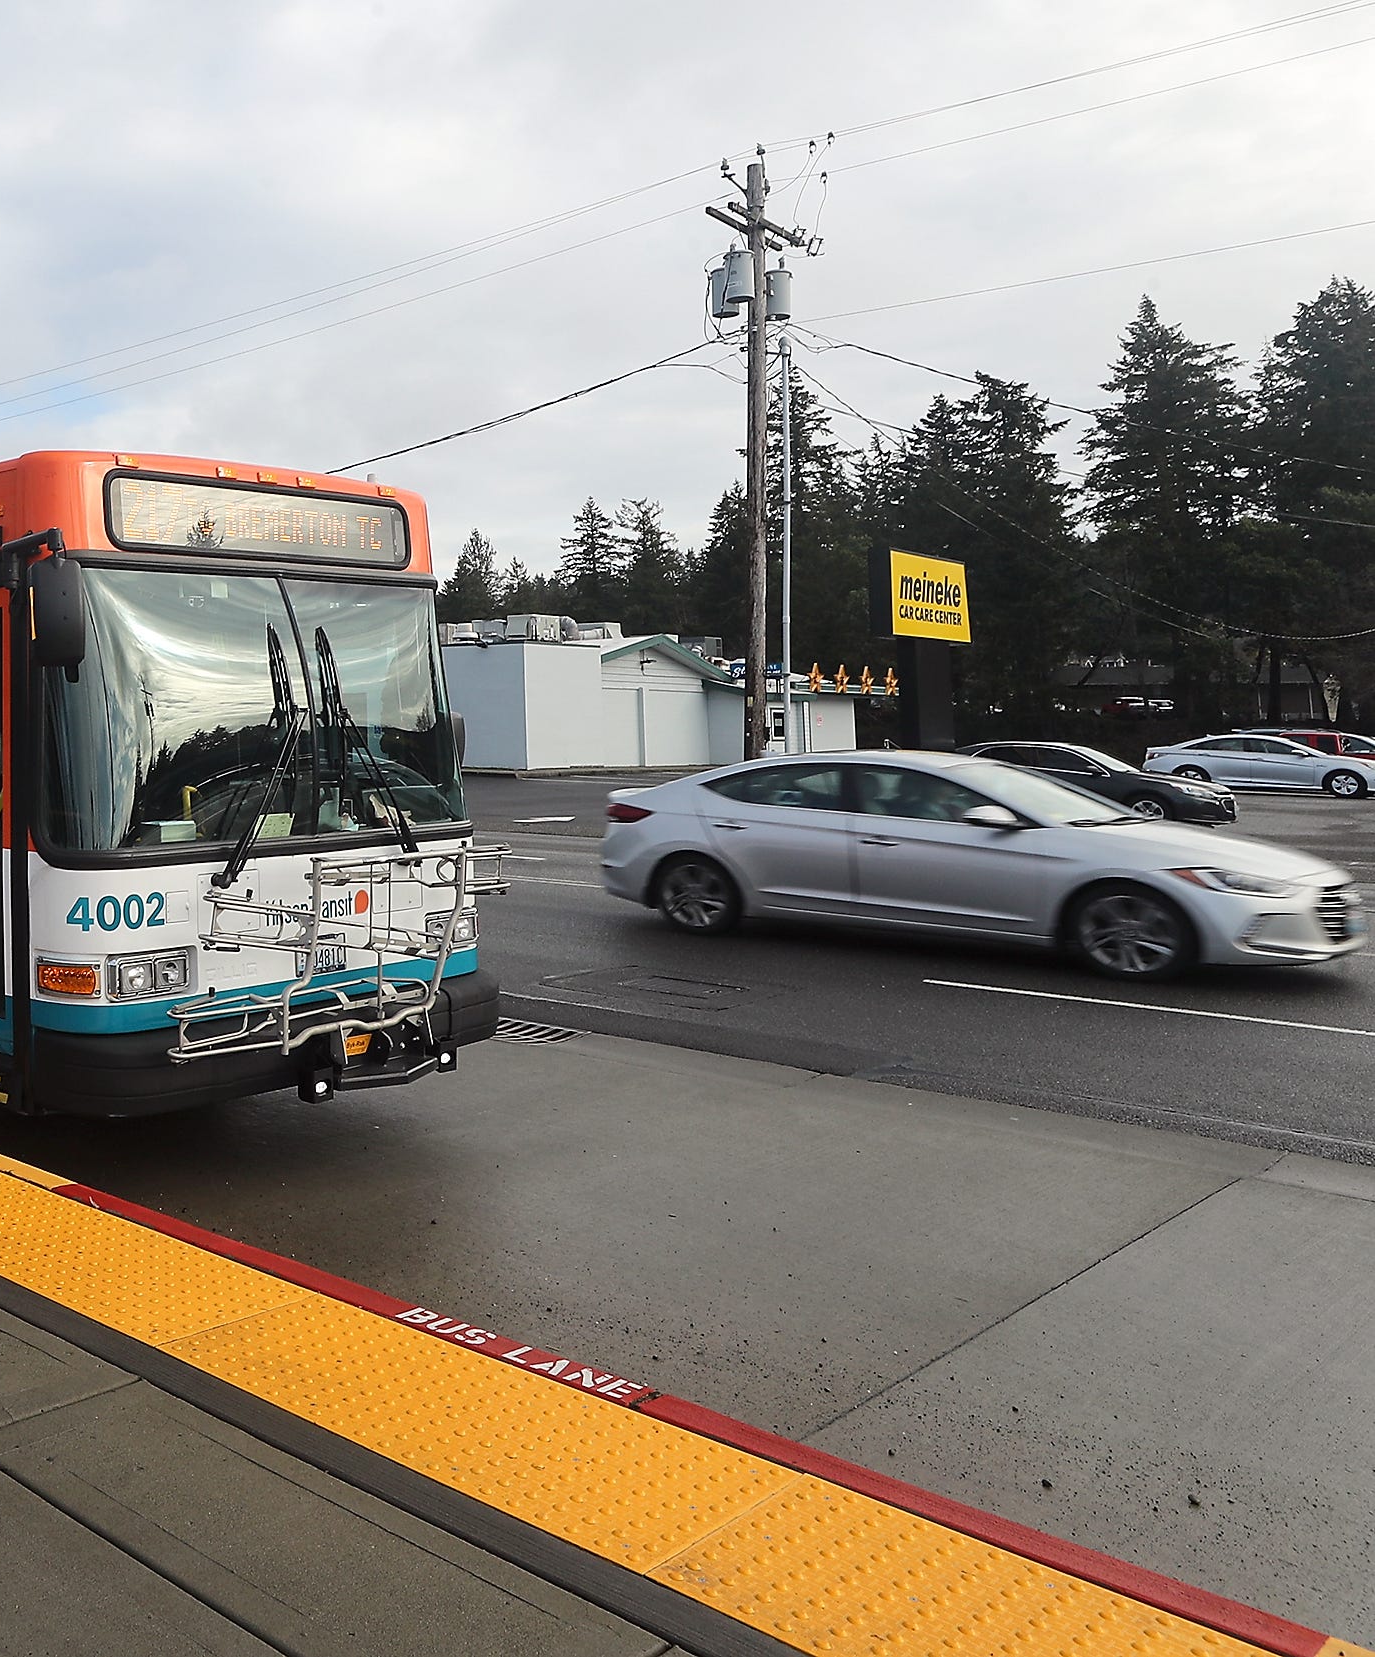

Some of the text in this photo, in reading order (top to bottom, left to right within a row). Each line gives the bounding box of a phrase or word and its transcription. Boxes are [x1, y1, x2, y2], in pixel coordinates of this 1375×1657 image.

[124, 481, 185, 541] 217
[225, 502, 347, 547] BREMERTON
[356, 515, 381, 549] TC
[900, 571, 961, 607] meineke
[899, 605, 961, 626] CAR CARE CENTER
[66, 891, 165, 932] 4002
[395, 1306, 643, 1399] BUS LANE
